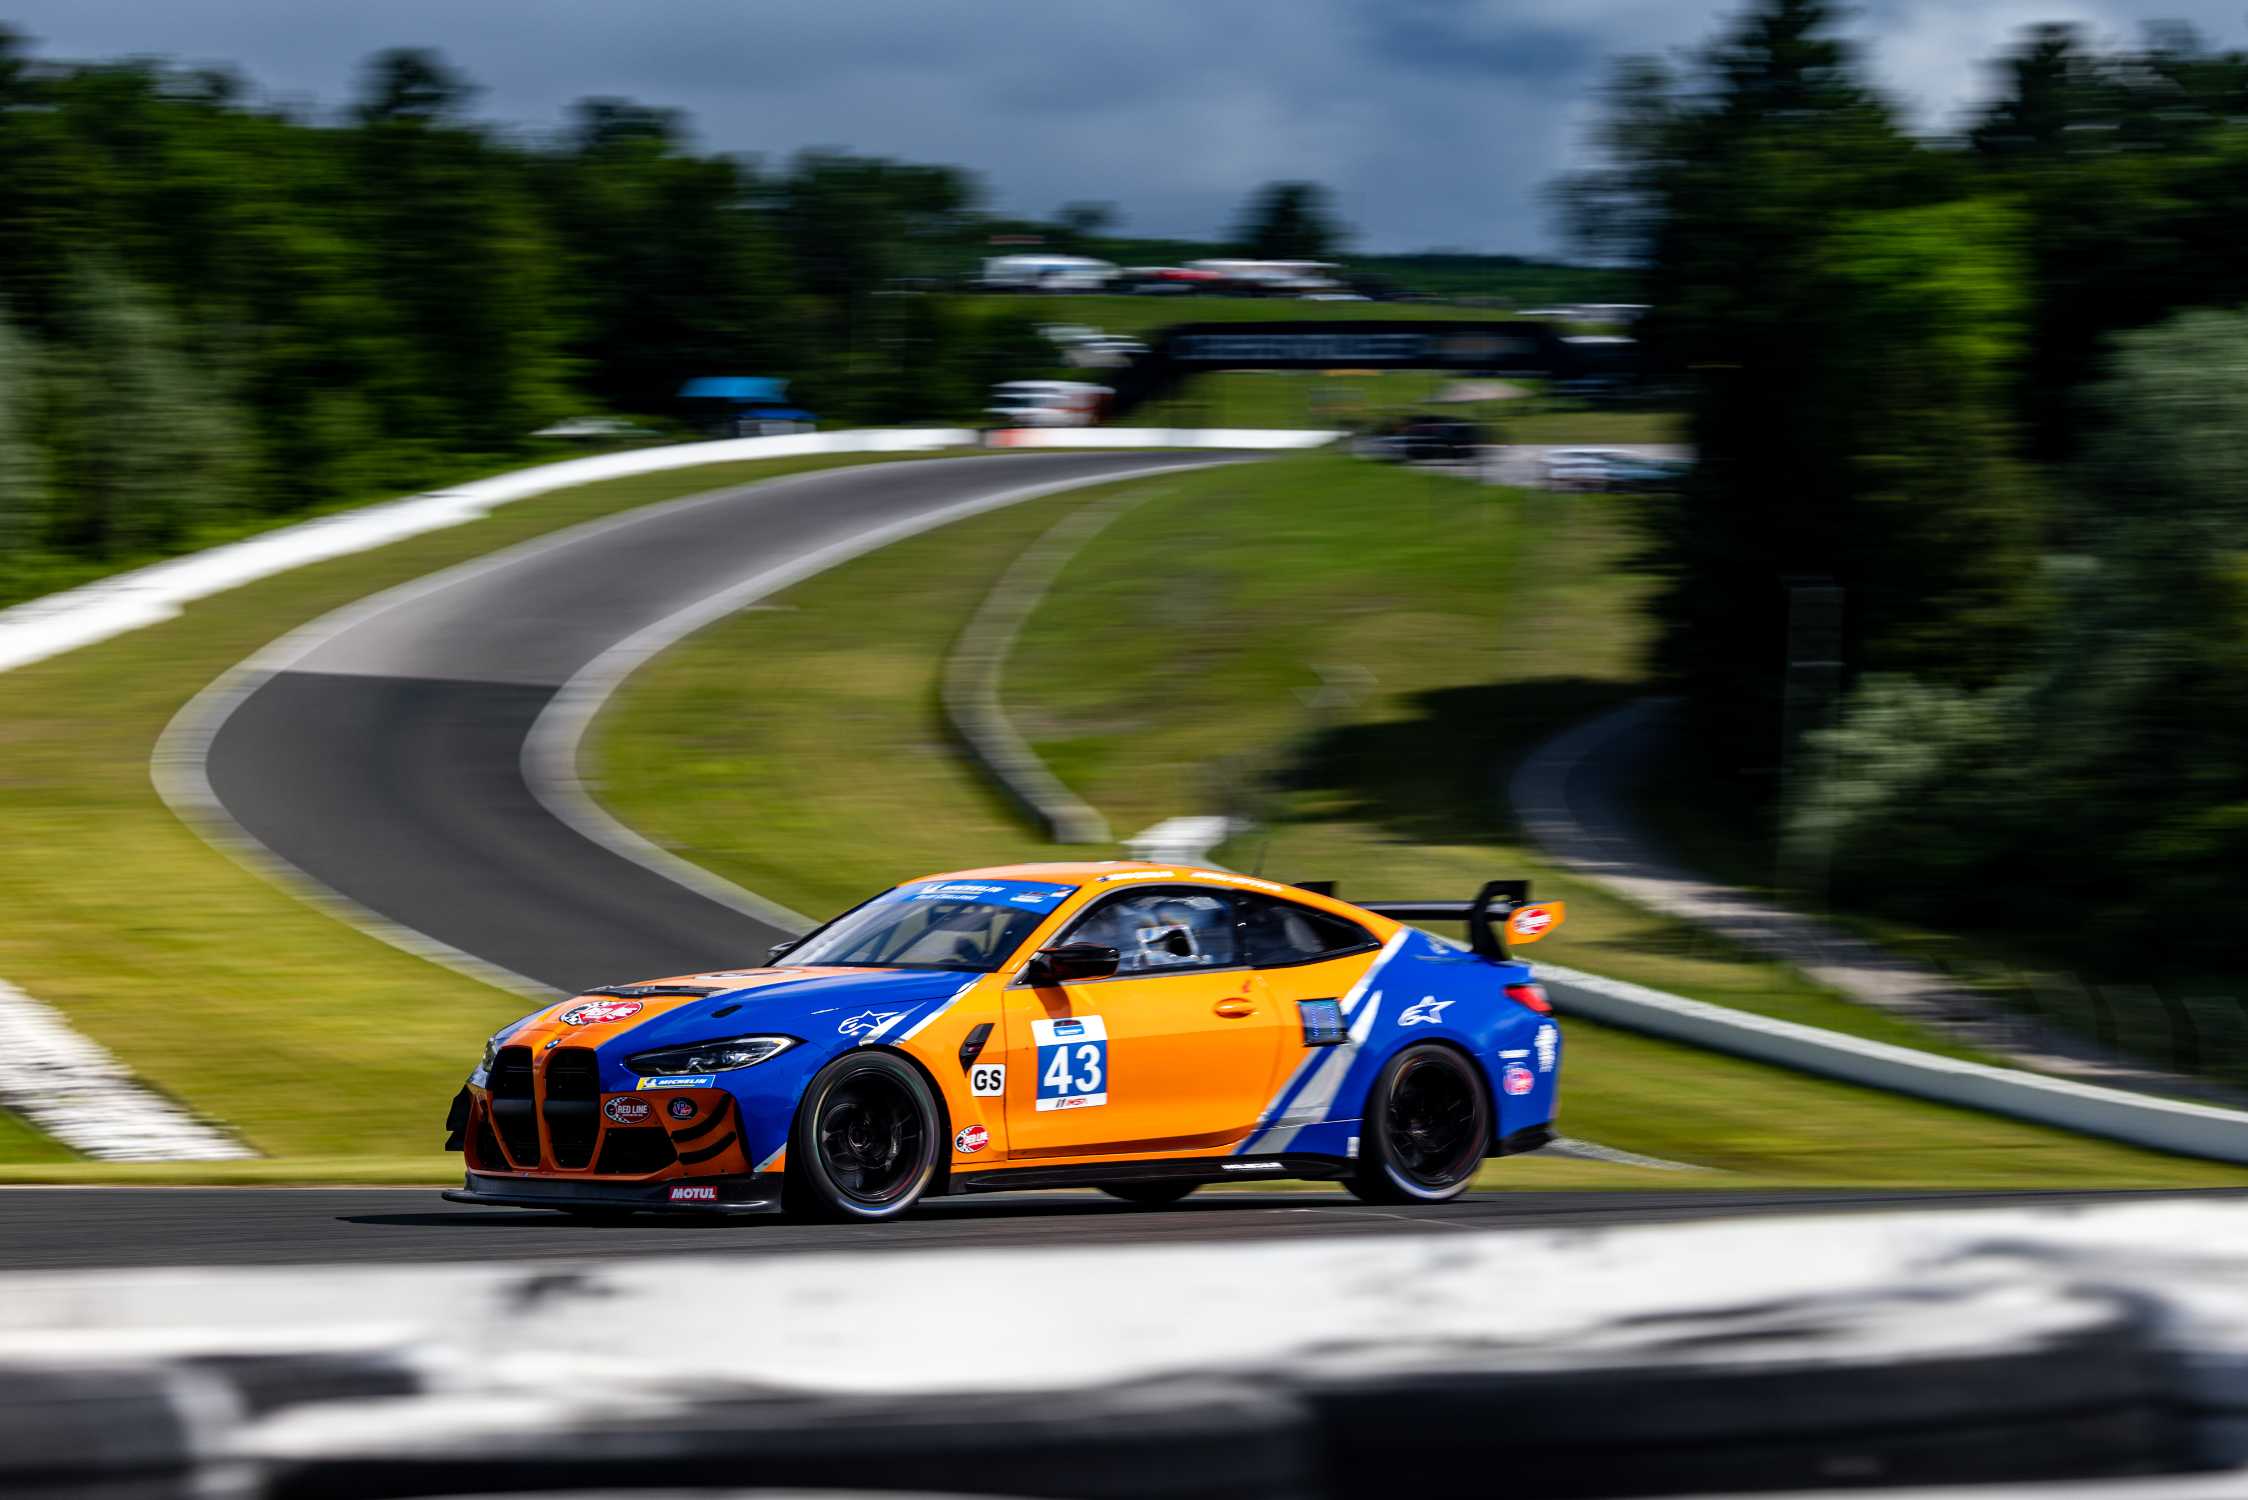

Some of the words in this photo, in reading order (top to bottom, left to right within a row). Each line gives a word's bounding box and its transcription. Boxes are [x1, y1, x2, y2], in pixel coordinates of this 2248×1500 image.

[1043, 1044, 1102, 1095] 43
[974, 1069, 1002, 1091] GS
[617, 1105, 631, 1114] RED
[632, 1105, 648, 1114] LINE
[671, 1187, 715, 1199] MOTUL
